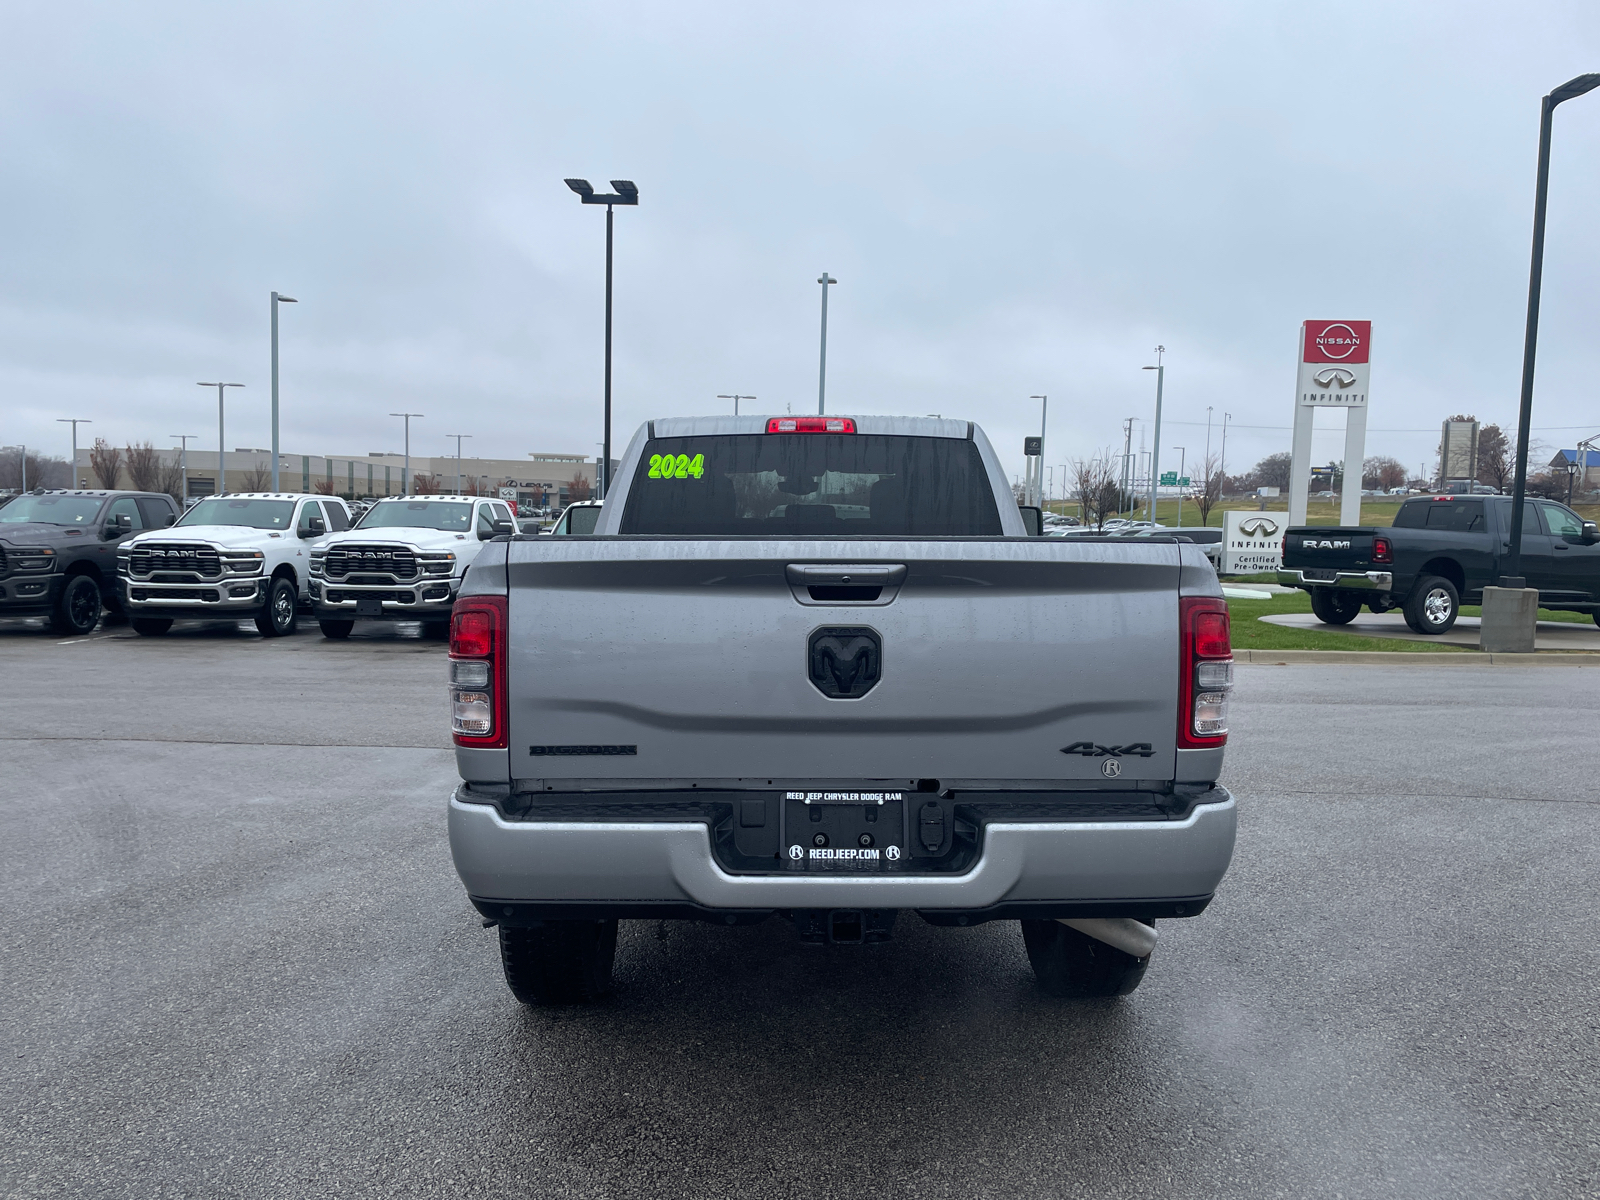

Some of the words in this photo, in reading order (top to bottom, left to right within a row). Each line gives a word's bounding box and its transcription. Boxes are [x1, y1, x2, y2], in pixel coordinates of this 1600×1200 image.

[1303, 393, 1364, 402] INFINITI
[648, 453, 704, 479] 2024
[1231, 541, 1279, 549] INFINIT
[1302, 540, 1350, 549] RAM
[786, 792, 804, 800] REED
[806, 792, 822, 800] JEEP
[860, 793, 884, 801] DODGE
[809, 849, 879, 859] REEDJEEP.COM
